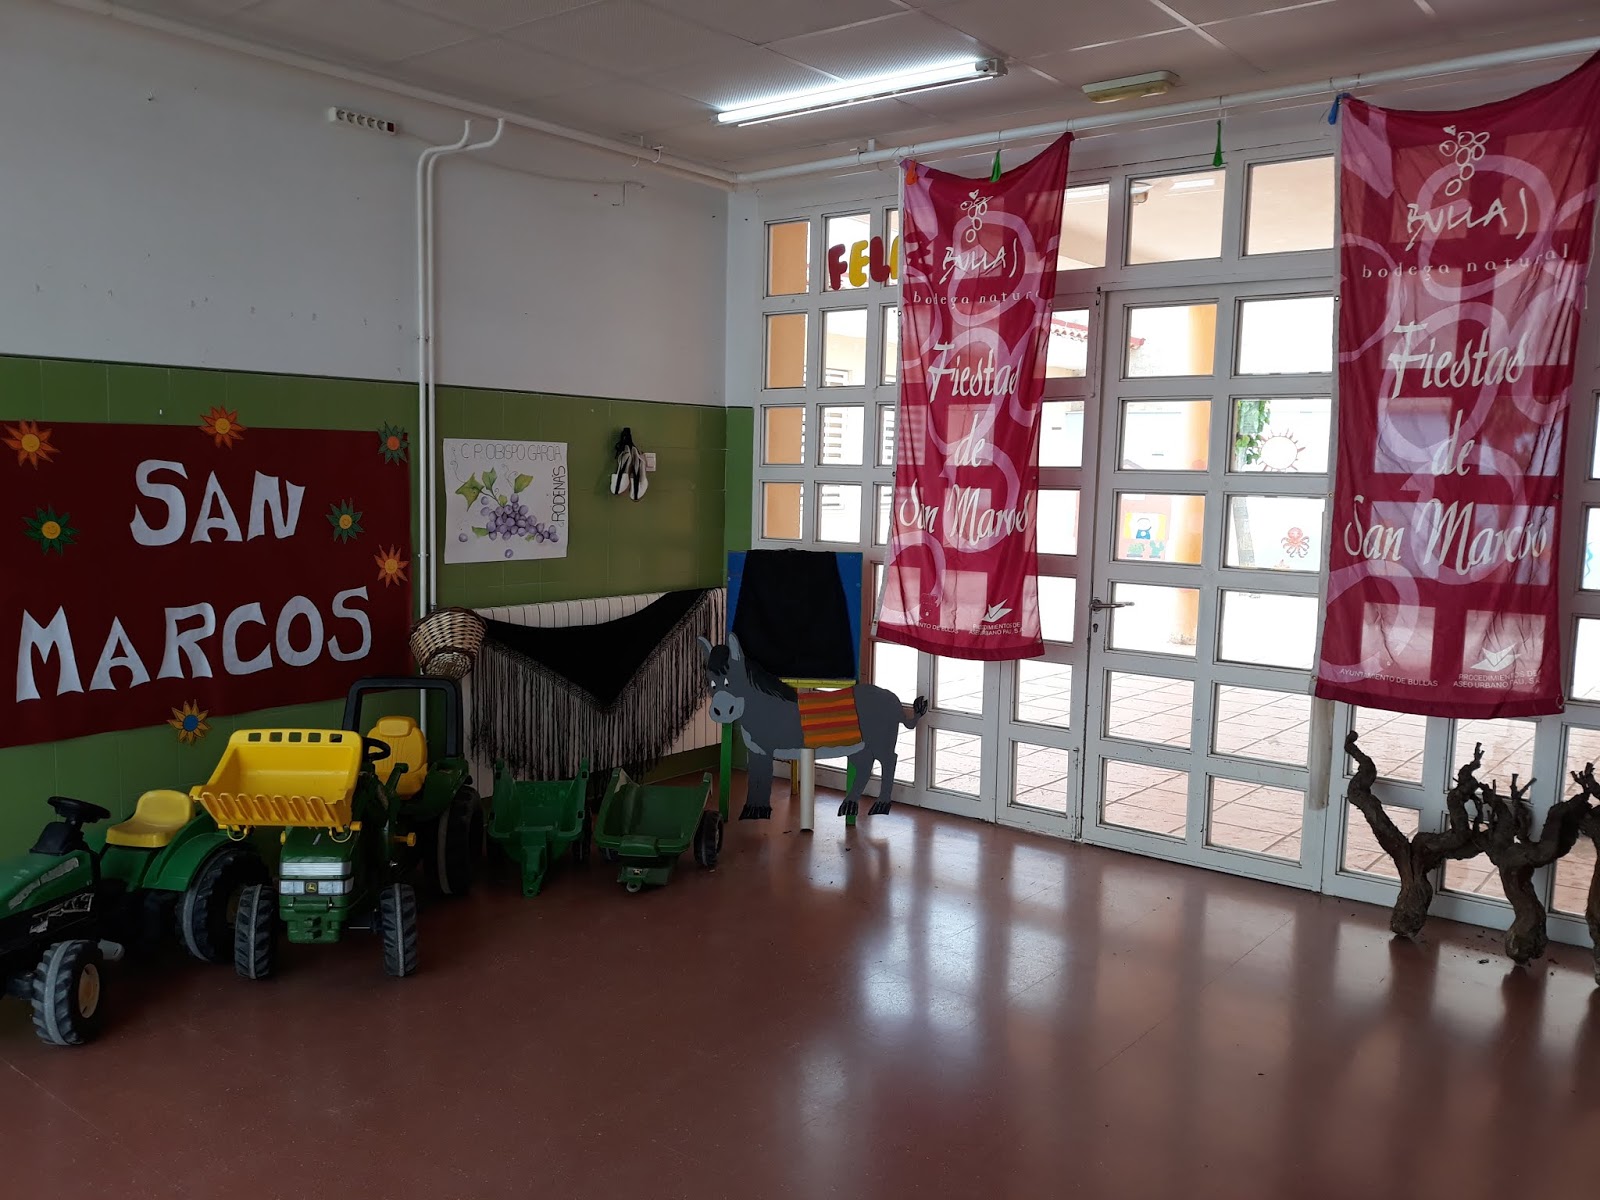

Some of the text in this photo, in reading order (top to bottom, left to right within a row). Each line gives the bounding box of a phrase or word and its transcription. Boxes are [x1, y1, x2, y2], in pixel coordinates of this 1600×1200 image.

[1405, 187, 1527, 251] BULLAS
[939, 238, 1018, 285] BULLAS
[1362, 243, 1568, 281] bodega natural
[913, 291, 970, 310] bodega
[927, 341, 1023, 403] Fiestas
[1387, 321, 1530, 399] Fiestas
[485, 443, 526, 460] OBISPO
[954, 413, 985, 467] de
[1431, 409, 1475, 476] de
[130, 459, 306, 546] SAN
[900, 478, 939, 534] San
[1344, 495, 1547, 575] San Marcos
[16, 586, 373, 703] MARCOS
[1396, 676, 1406, 684] DE
[1407, 679, 1439, 687] BULLAS
[1474, 681, 1508, 689] URBANO
